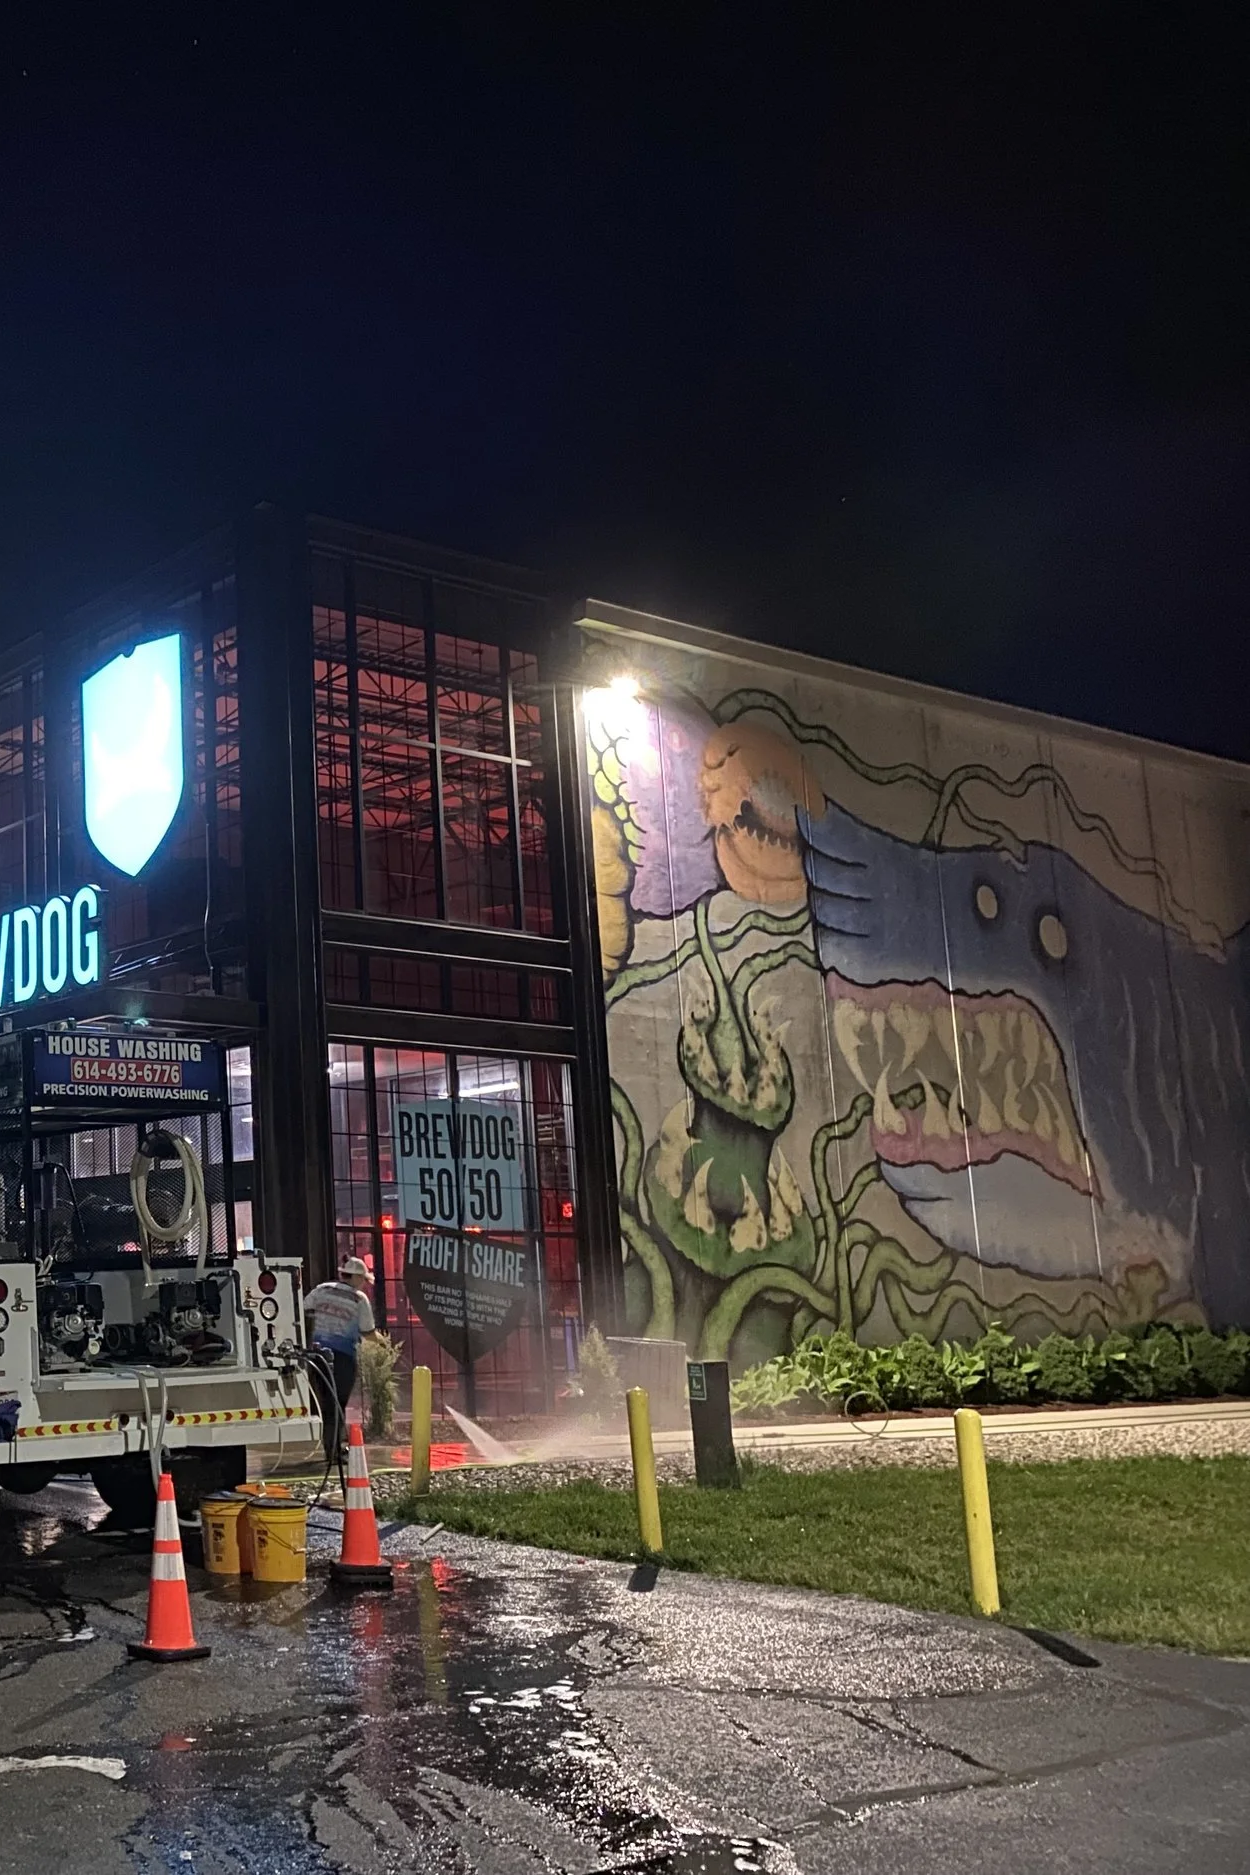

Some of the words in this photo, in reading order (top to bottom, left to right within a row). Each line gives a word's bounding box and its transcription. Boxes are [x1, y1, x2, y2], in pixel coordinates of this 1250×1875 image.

[47, 1035, 111, 1057] HOUSE
[116, 1039, 202, 1062] WASHING
[73, 1060, 181, 1084] 614-493-6776
[43, 1083, 107, 1097] PRECISION
[110, 1085, 210, 1101] POWERWASHING
[397, 1110, 516, 1161] BREWDOG
[408, 1233, 471, 1274] PROFIT
[472, 1243, 526, 1288] SHARE
[420, 1282, 436, 1292] THIS
[436, 1285, 451, 1296] BAR
[423, 1292, 434, 1302] OF
[434, 1295, 446, 1305] ITS
[446, 1298, 476, 1312] PROFTS
[427, 1303, 459, 1316] AMAZING
